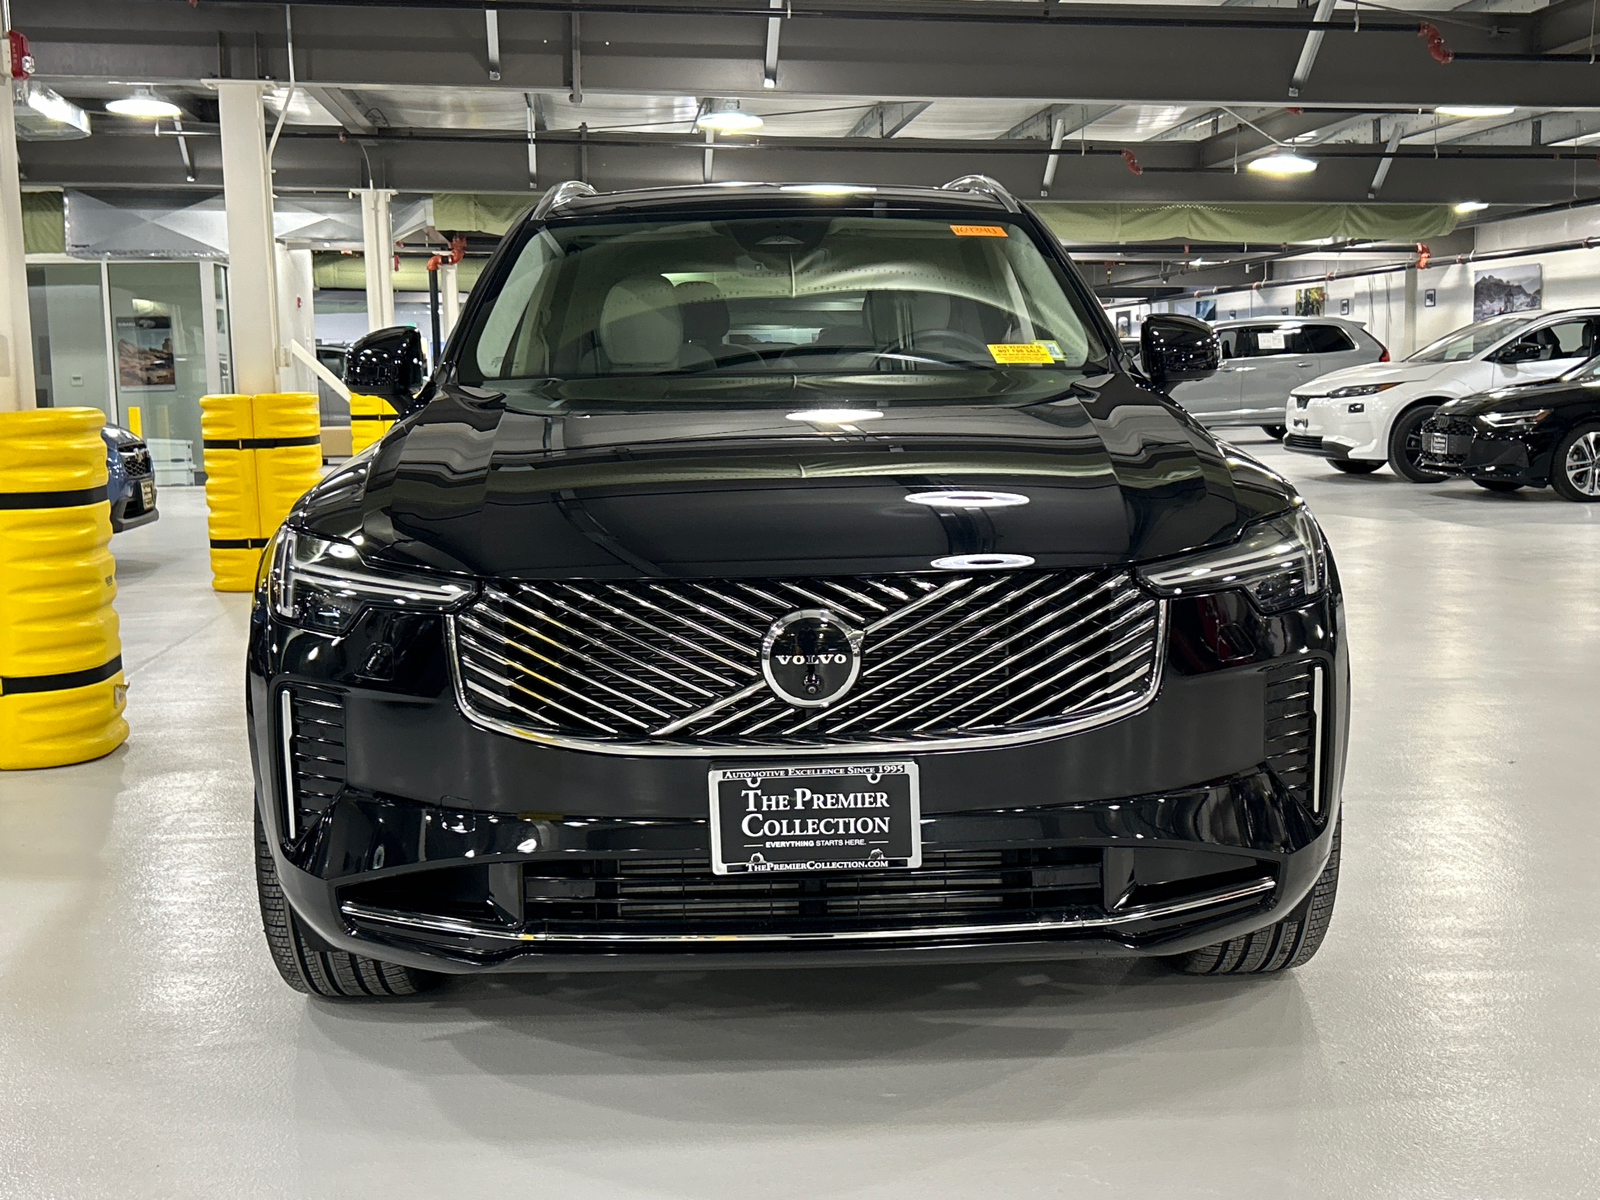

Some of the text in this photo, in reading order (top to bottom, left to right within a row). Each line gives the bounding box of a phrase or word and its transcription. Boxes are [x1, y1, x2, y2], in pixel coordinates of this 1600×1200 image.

[775, 653, 847, 665] VOLVO
[724, 765, 904, 779] AUTOMOTIVE EXCELLENCE SINCE 1995
[741, 787, 890, 812] THE PREMIER
[741, 813, 891, 838] COLLECTION
[765, 838, 867, 848] EVERYTHING STARTS HERE.
[745, 860, 889, 872] THEPREMIERCOLLECTION.COM
